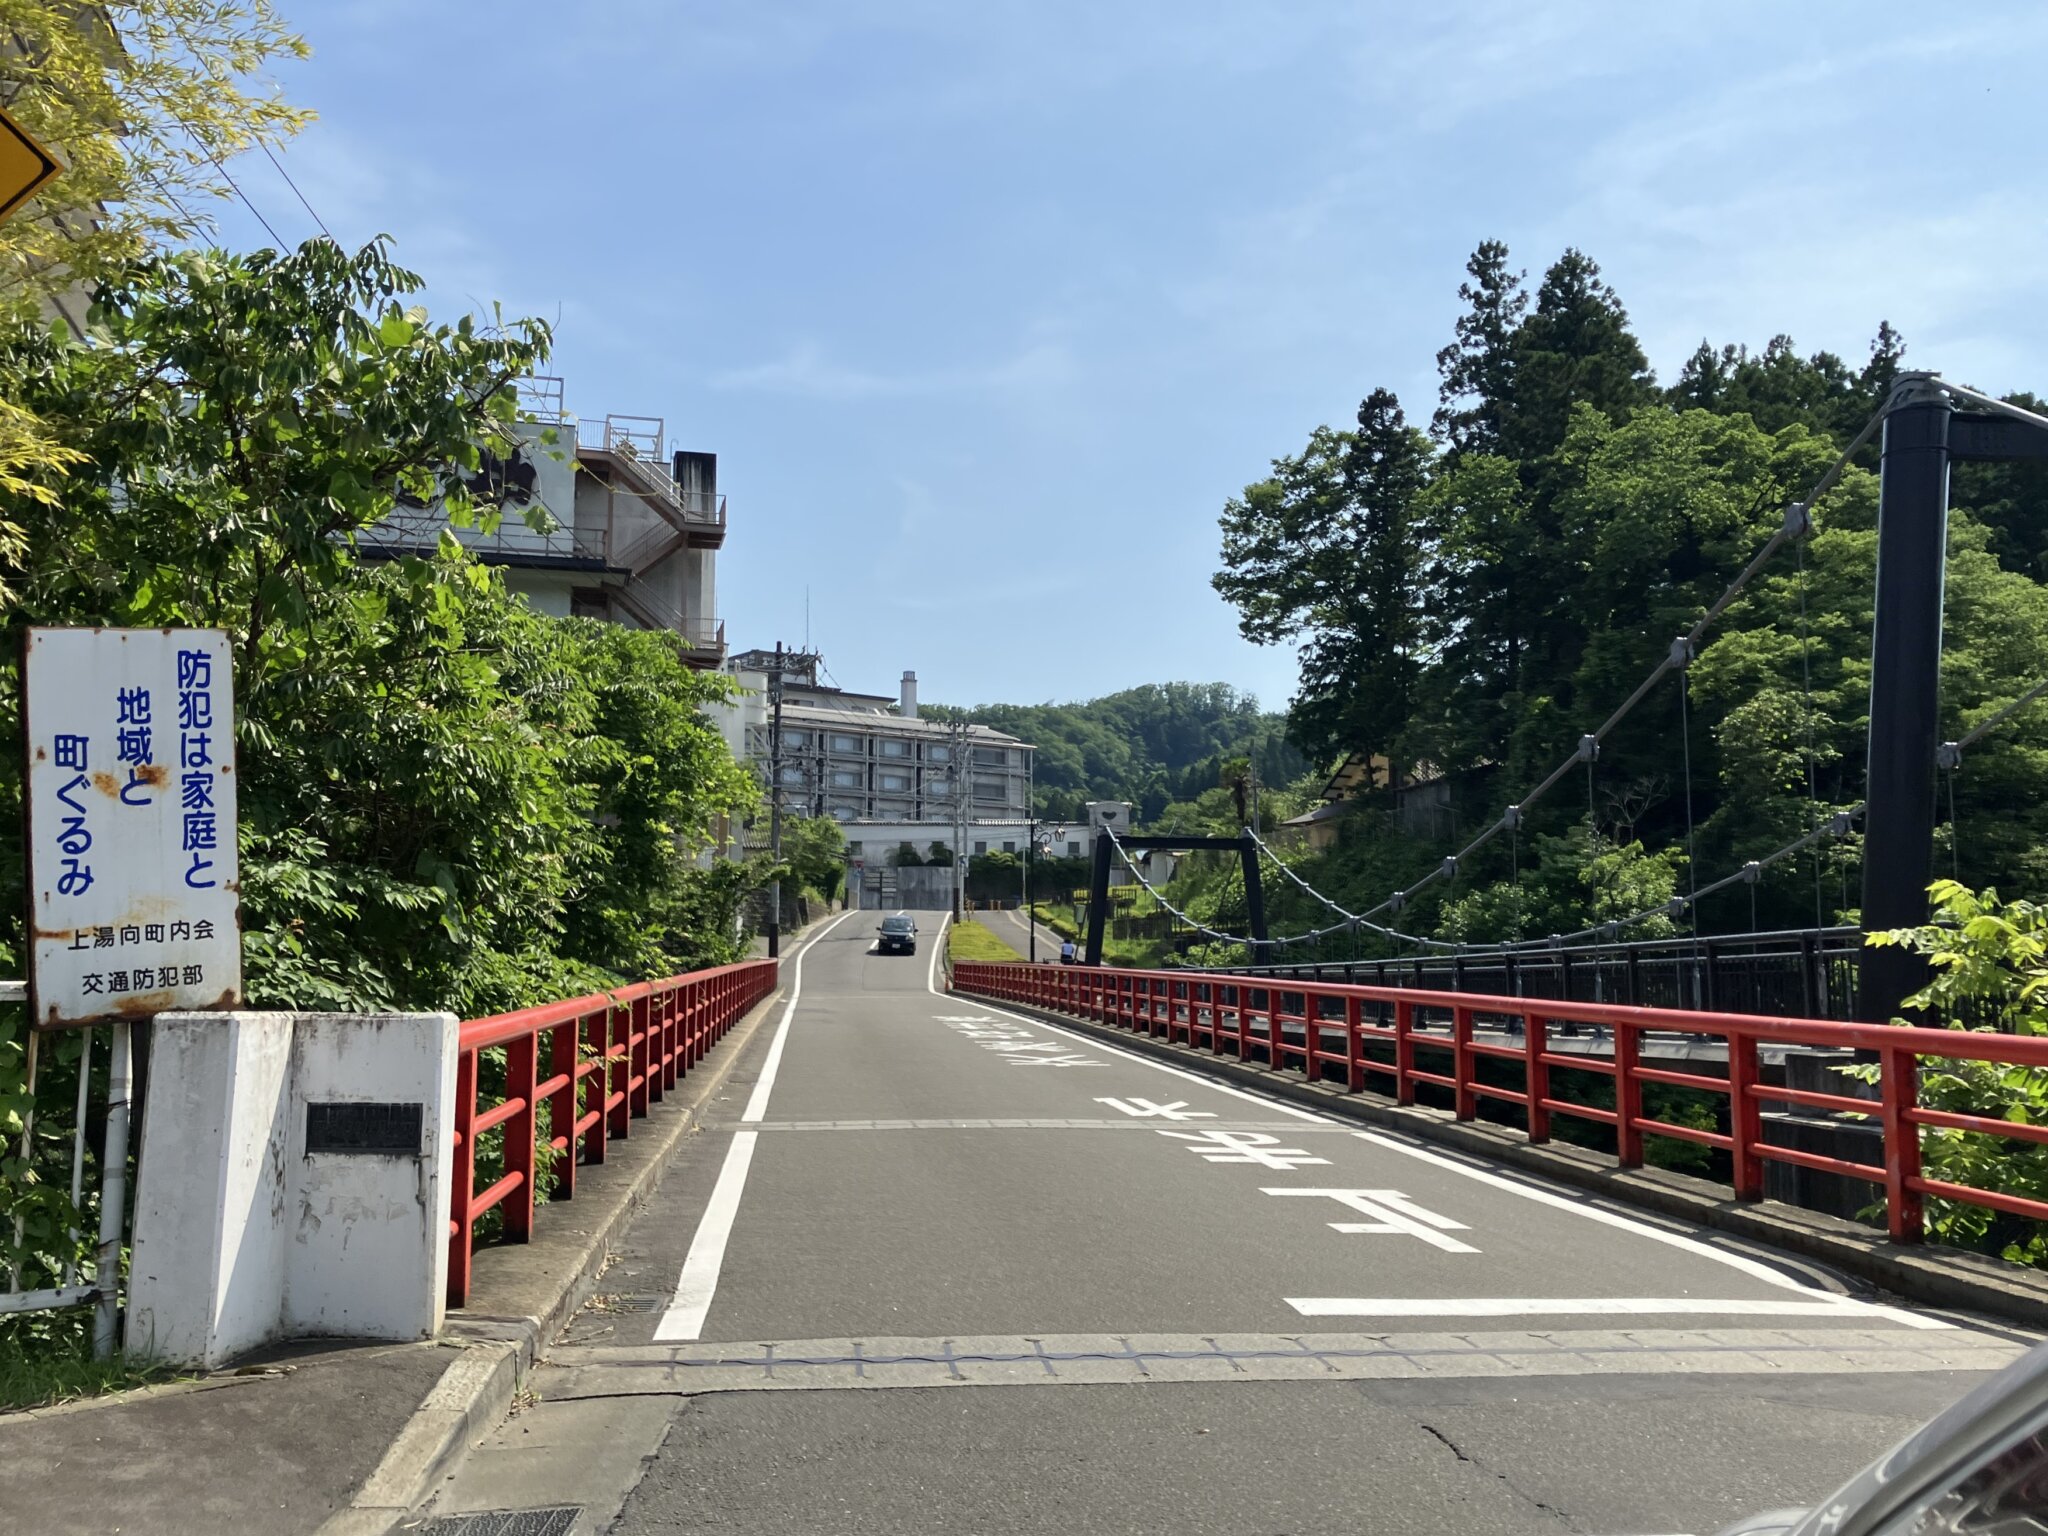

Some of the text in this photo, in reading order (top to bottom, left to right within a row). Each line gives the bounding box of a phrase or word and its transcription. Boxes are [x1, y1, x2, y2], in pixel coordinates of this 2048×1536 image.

[54, 734, 95, 896] 町ぐるみ
[116, 687, 153, 806] 地域と
[177, 650, 217, 889] 防犯は家庭と
[67, 919, 215, 951] 上湯向町内会
[82, 964, 204, 995] 交通防犯部
[1094, 1098, 1482, 1253] 止まれ
